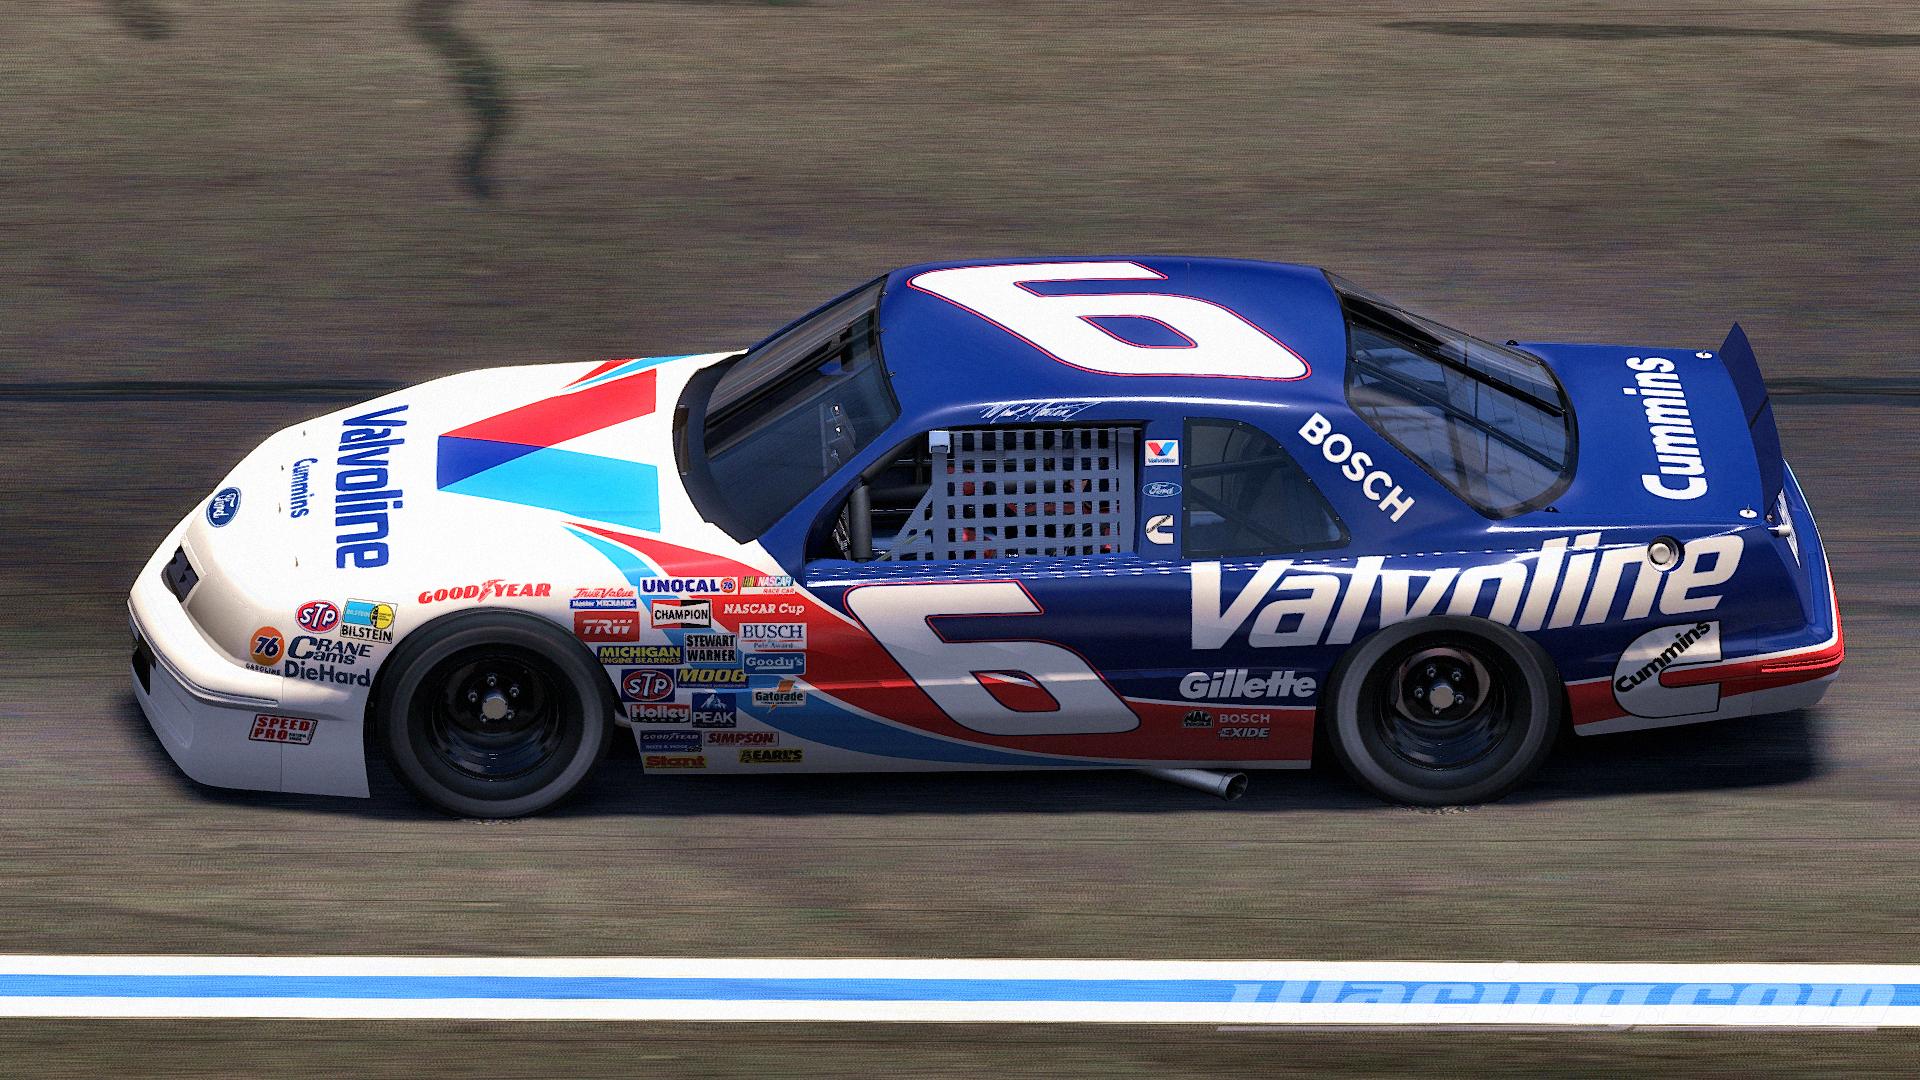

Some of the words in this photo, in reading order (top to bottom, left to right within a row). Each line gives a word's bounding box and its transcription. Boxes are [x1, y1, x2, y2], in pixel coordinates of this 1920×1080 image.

[907, 261, 1312, 381] 6
[1623, 356, 1708, 500] Cummins
[1298, 411, 1415, 522] BOSCH
[290, 457, 318, 518] Cummins
[334, 404, 409, 569] Valvoline
[1149, 483, 1174, 495] Ford
[212, 492, 237, 519] Ford
[642, 579, 720, 593] UNOCAL
[722, 581, 733, 590] 76
[757, 576, 793, 587] NASCAR
[418, 580, 551, 604] GOODYEAR
[1189, 533, 1744, 649] Valvoline
[300, 603, 336, 628] STP
[654, 609, 709, 620] CHAMPION
[723, 603, 775, 615] NASCAR
[779, 603, 805, 615] Cup
[342, 625, 393, 642] BILSTEIN
[583, 619, 633, 635] TRW
[742, 624, 804, 639] BUSCH
[254, 635, 280, 658] 76
[686, 635, 736, 647] STEWART
[599, 646, 681, 657] MICHIGAN
[687, 650, 736, 661] WARNER
[843, 579, 1142, 736] 6
[1615, 621, 1711, 692] Cummins
[245, 662, 281, 676] GASOLINE
[745, 656, 804, 670] Goody's
[284, 660, 371, 687] DieHard
[678, 669, 747, 682] MOOG
[628, 672, 668, 697] STP
[1179, 669, 1317, 699] Gillette
[755, 691, 804, 702] Gatorade
[631, 704, 690, 723] Holley
[692, 711, 734, 724] PEAK
[1219, 713, 1270, 723] BOSCH
[257, 716, 311, 732] SPEED
[253, 727, 288, 741] PRO
[707, 732, 775, 746] SIMPSON
[1219, 727, 1270, 738] EXIDE
[645, 755, 705, 768] Stant
